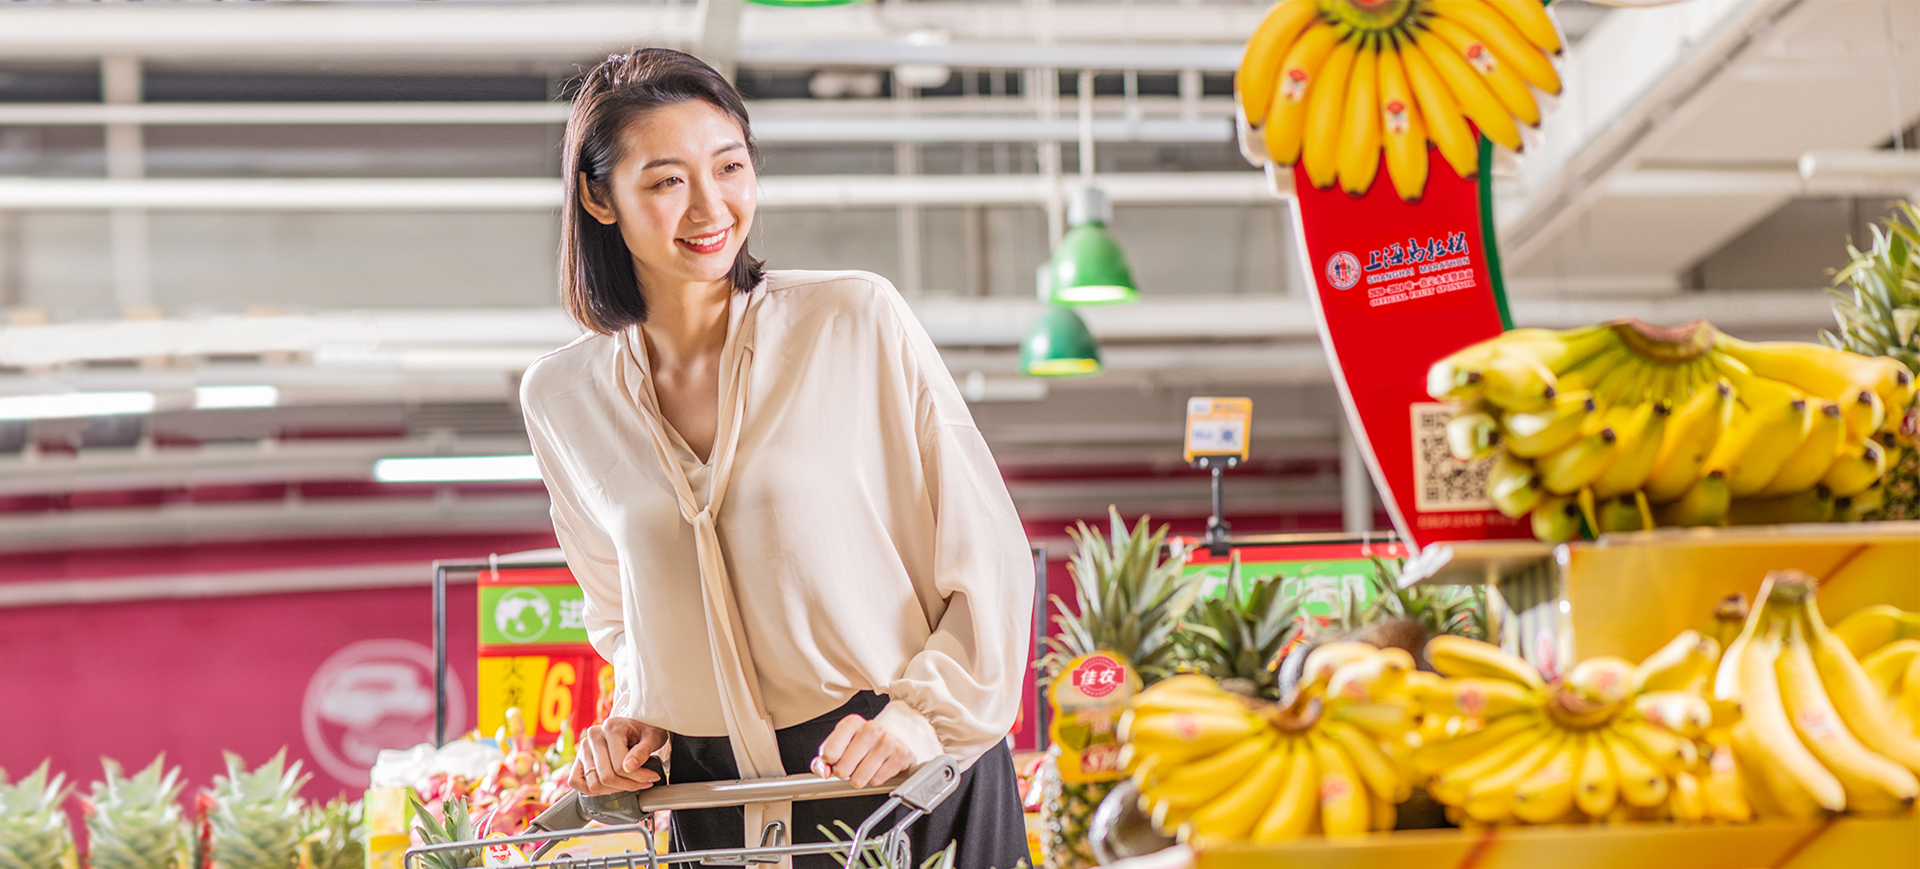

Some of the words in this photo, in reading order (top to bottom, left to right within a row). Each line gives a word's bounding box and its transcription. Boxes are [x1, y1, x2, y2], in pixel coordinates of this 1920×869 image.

[1367, 267, 1415, 284] SHANGHAI
[1419, 256, 1470, 274] MARATHON
[1369, 292, 1409, 307] OFFICIAL
[1409, 287, 1435, 299] FRUIT
[1436, 279, 1476, 294] SPONSOR
[1249, 574, 1367, 604] 口商品
[1080, 668, 1116, 686] 佳农
[540, 661, 576, 733] 6
